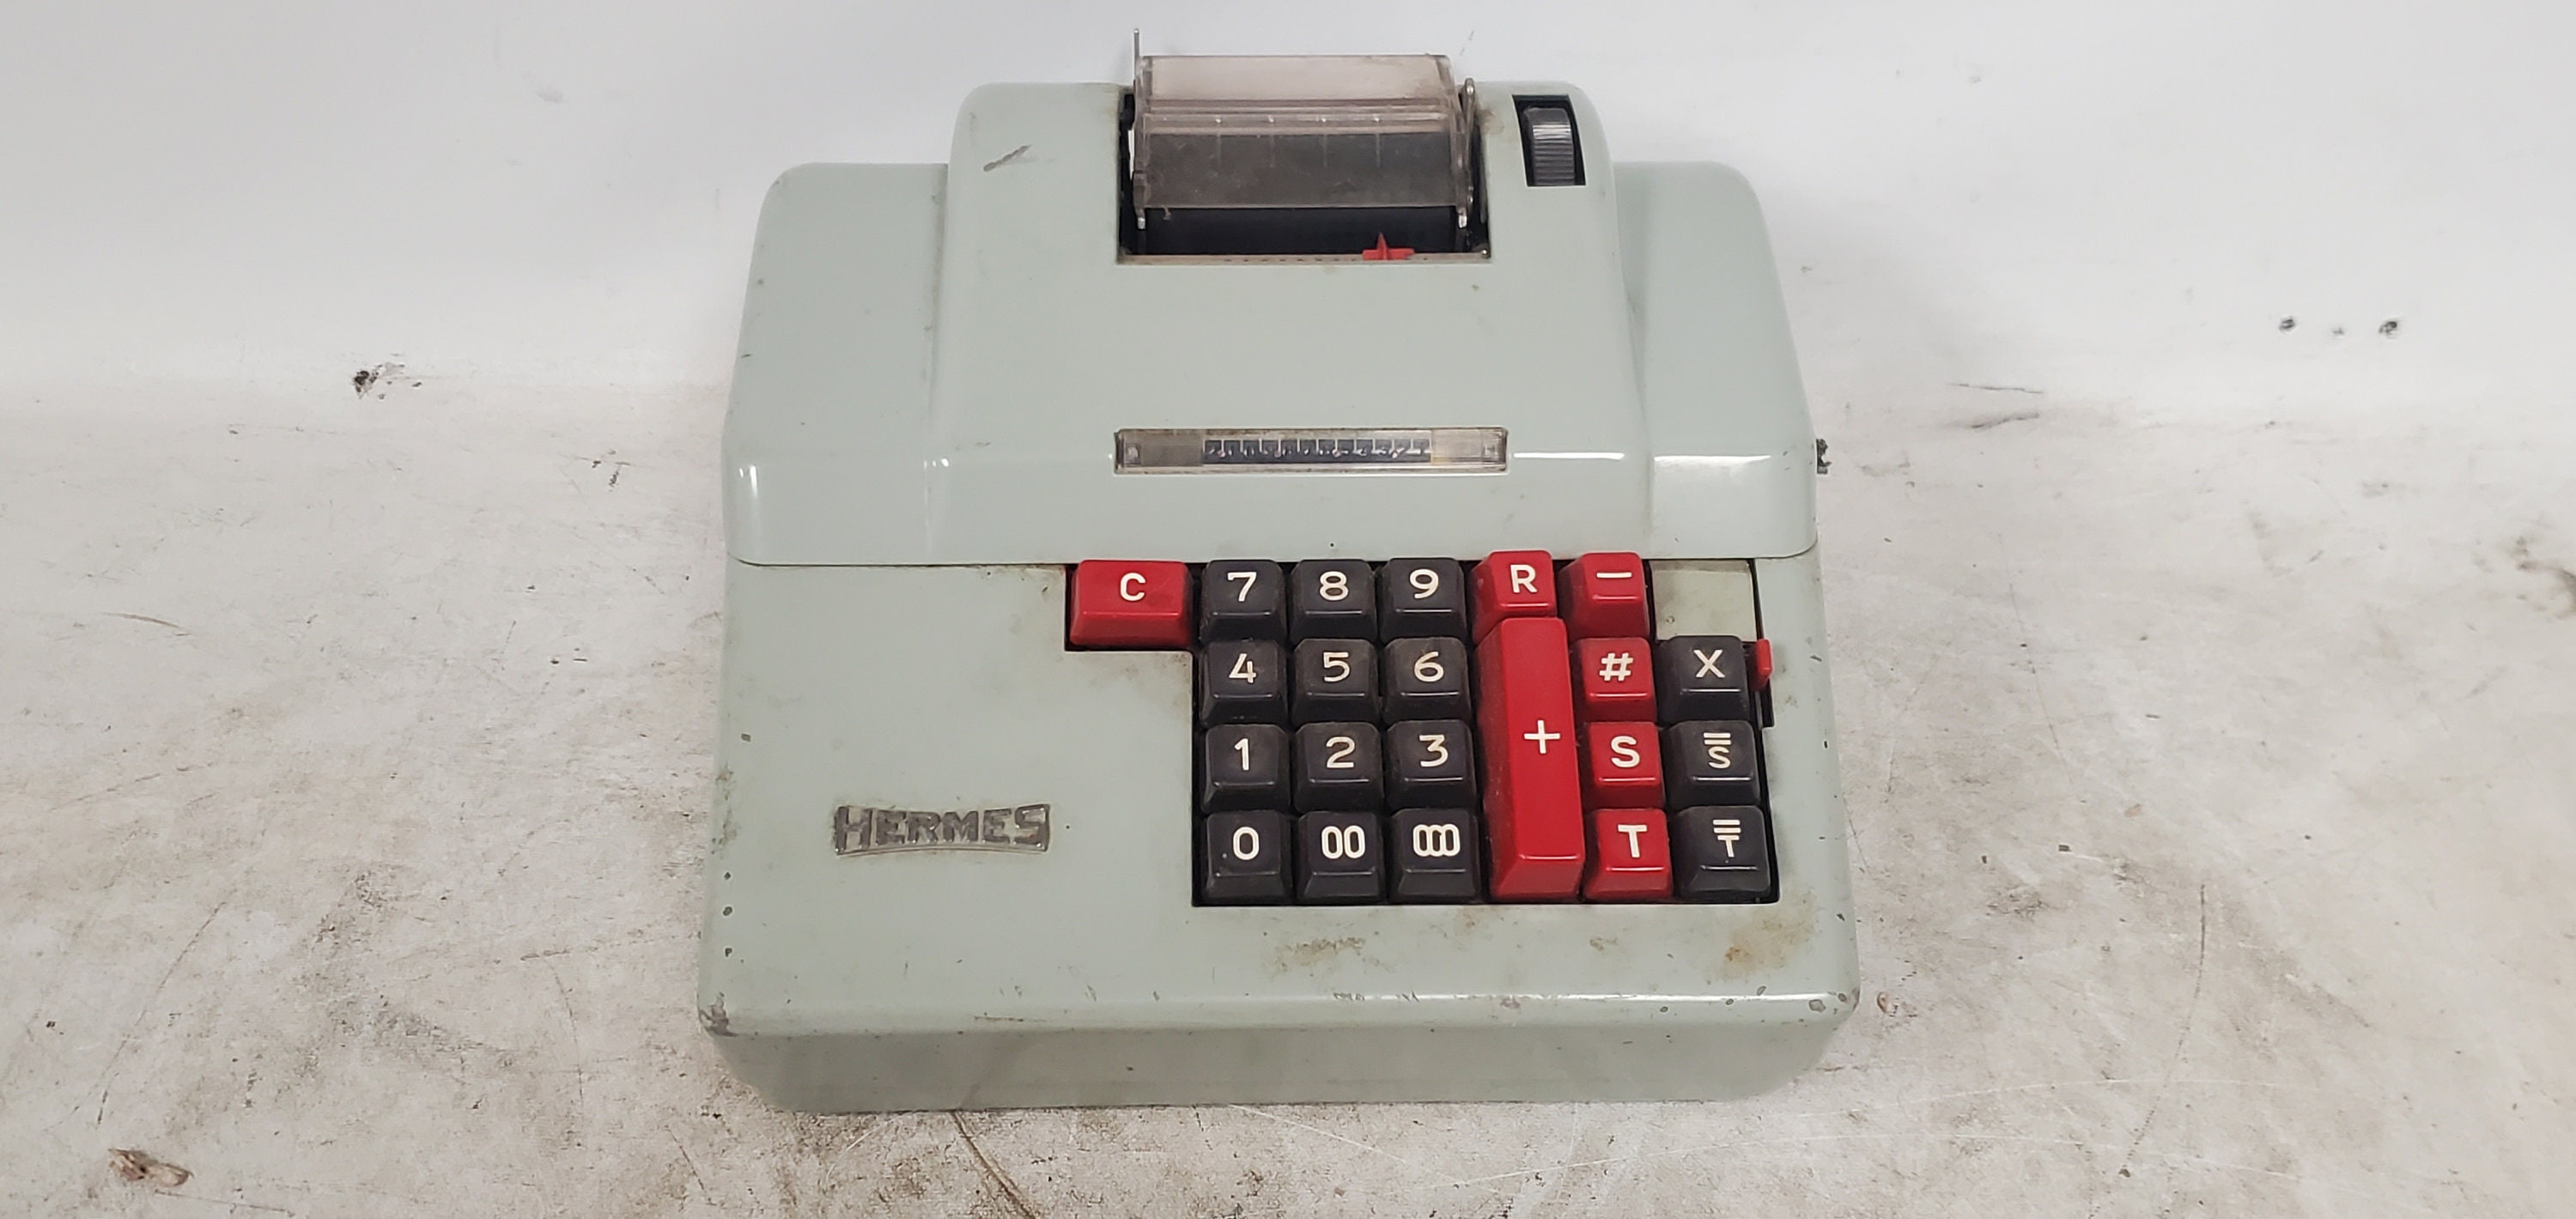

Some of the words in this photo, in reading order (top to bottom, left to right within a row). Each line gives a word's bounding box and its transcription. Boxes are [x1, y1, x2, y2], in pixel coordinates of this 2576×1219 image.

[1120, 572, 1146, 602] C
[1227, 571, 1257, 602] 7
[1319, 571, 1349, 601] 8
[1409, 568, 1439, 599] 9
[1510, 564, 1538, 593] R
[1228, 652, 1257, 683] 4
[1323, 652, 1350, 682] 5
[1413, 651, 1444, 682] 6
[1599, 652, 1634, 682] #
[1692, 649, 1726, 678] X
[1326, 736, 1356, 768] 2
[1419, 734, 1449, 767] 3
[1523, 719, 1561, 755] +
[1611, 735, 1640, 768] S
[1234, 737, 1249, 771] 1
[835, 804, 1049, 852] HERMES
[1232, 826, 1260, 860] 0
[1321, 825, 1366, 859] 00
[1617, 824, 1648, 858] T
